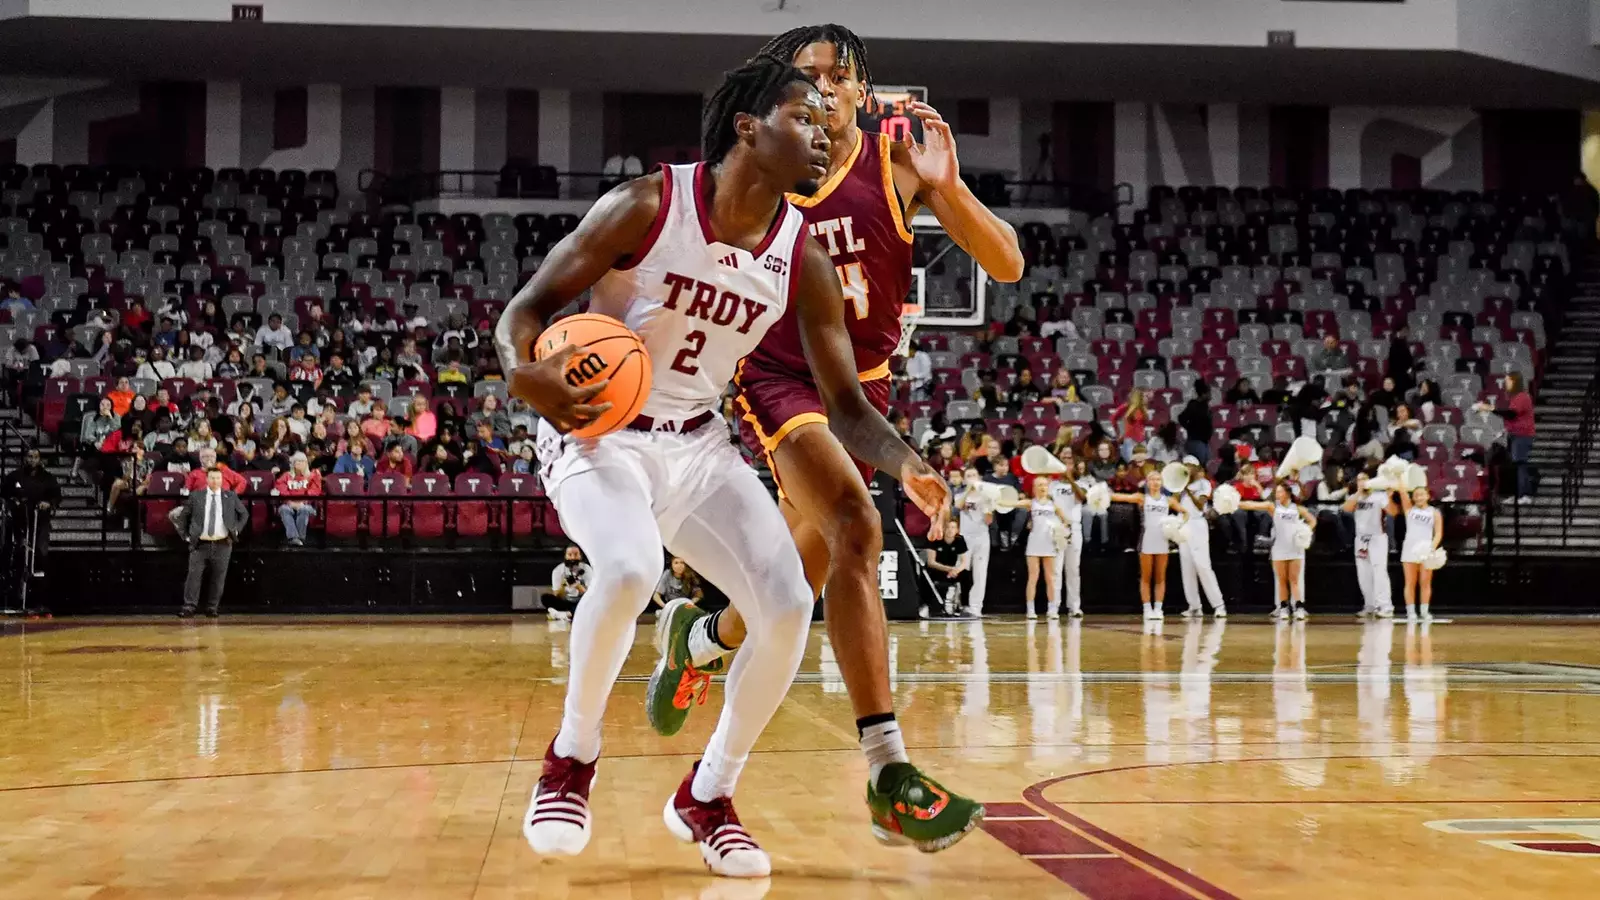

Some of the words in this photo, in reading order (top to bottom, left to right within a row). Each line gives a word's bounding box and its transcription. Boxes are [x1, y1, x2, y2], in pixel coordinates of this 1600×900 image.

[809, 216, 866, 256] TL
[663, 271, 768, 335] TROY
[670, 329, 706, 376] 2
[940, 374, 948, 383] T
[1008, 374, 1016, 384] T
[1042, 374, 1050, 384] T
[1076, 375, 1085, 384] T
[1110, 375, 1119, 385] T
[1146, 376, 1154, 385] T
[1216, 378, 1224, 387] T
[1497, 379, 1504, 388] T
[58, 382, 67, 392] T
[96, 382, 105, 393] T
[134, 383, 144, 392] T
[174, 382, 183, 393] T
[213, 384, 222, 394] T
[254, 384, 262, 394] T
[292, 385, 302, 396] T
[332, 386, 341, 396] T
[371, 385, 380, 396] T
[410, 387, 418, 395] T
[448, 387, 457, 397] T
[946, 390, 955, 399] T
[1164, 394, 1172, 403] T
[78, 400, 87, 410] T
[1453, 396, 1463, 406] T
[1488, 396, 1496, 404] T
[401, 402, 409, 412] T
[921, 406, 930, 416] T
[996, 408, 1006, 418] T
[1034, 408, 1044, 418] T
[1146, 410, 1154, 420] T
[1220, 410, 1229, 421] T
[1257, 410, 1266, 420] T
[1330, 411, 1340, 422] T
[1443, 412, 1451, 422] T
[962, 425, 971, 433] T
[999, 424, 1009, 435] T
[1036, 426, 1045, 436] T
[1145, 428, 1153, 436] T
[1216, 429, 1226, 439] T
[1252, 429, 1262, 440] T
[1325, 430, 1332, 439] T
[1436, 430, 1446, 440] T
[1473, 430, 1483, 440] T
[1426, 447, 1436, 459] T
[1456, 466, 1466, 477] T
[162, 477, 173, 490] T
[250, 477, 262, 490] T
[339, 479, 350, 491] T
[382, 479, 393, 492] T
[424, 479, 436, 492] T
[468, 479, 479, 491] T
[512, 479, 522, 491] T
[1447, 485, 1457, 495] T
